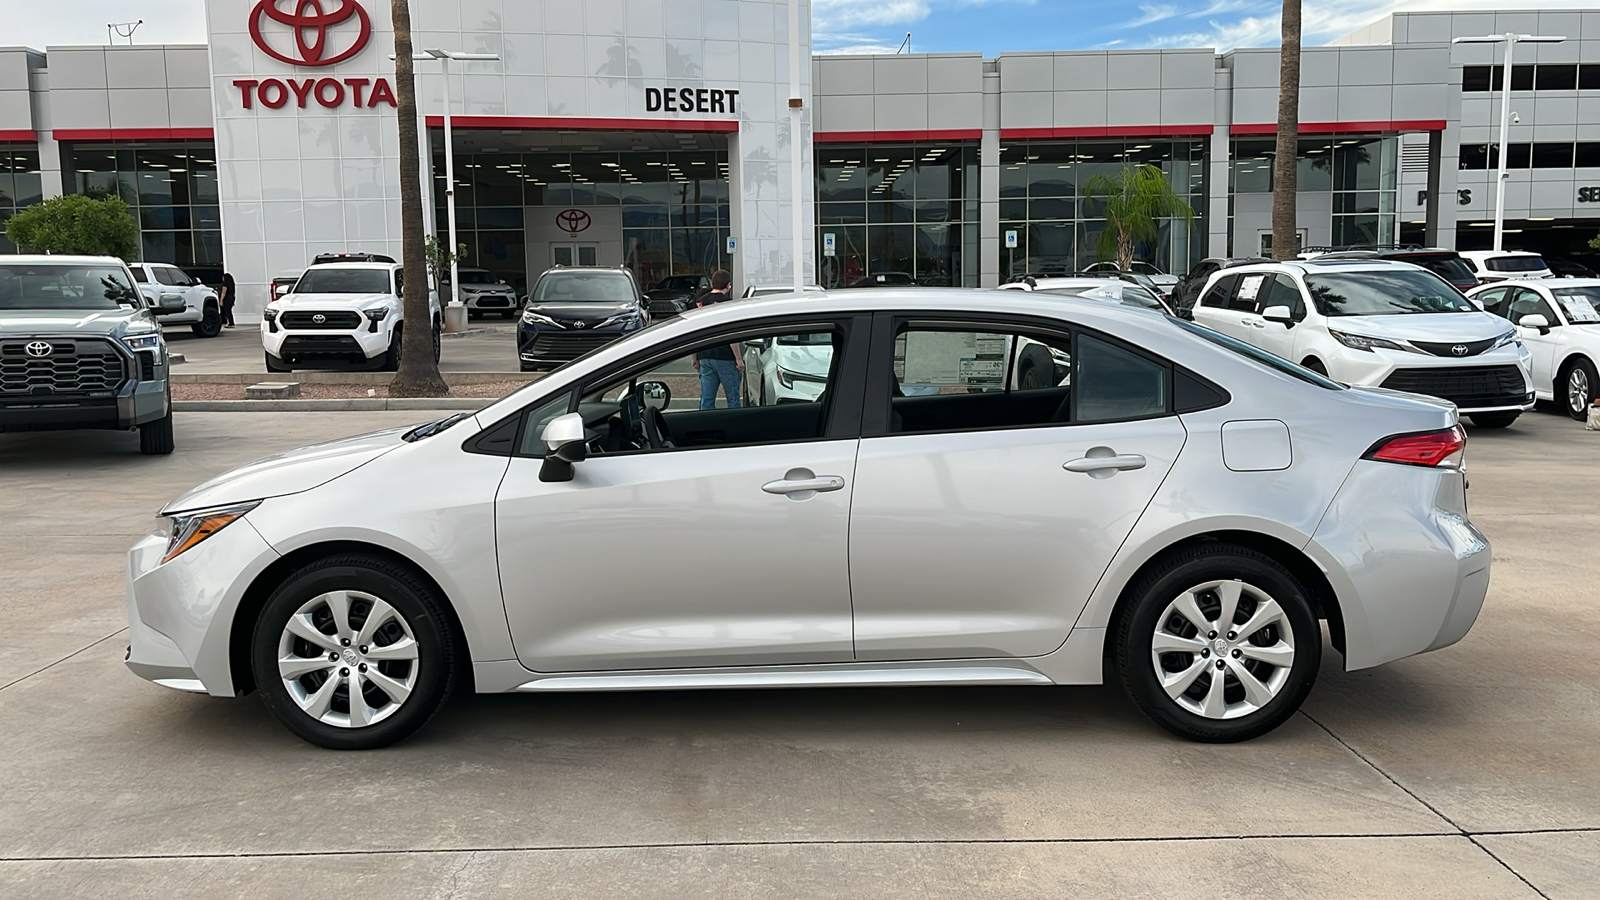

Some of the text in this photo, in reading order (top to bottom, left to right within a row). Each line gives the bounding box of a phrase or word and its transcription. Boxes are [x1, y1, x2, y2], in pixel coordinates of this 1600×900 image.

[233, 78, 398, 109] TOYOTA
[645, 87, 740, 113] DESERT
[1577, 186, 1600, 203] SE
